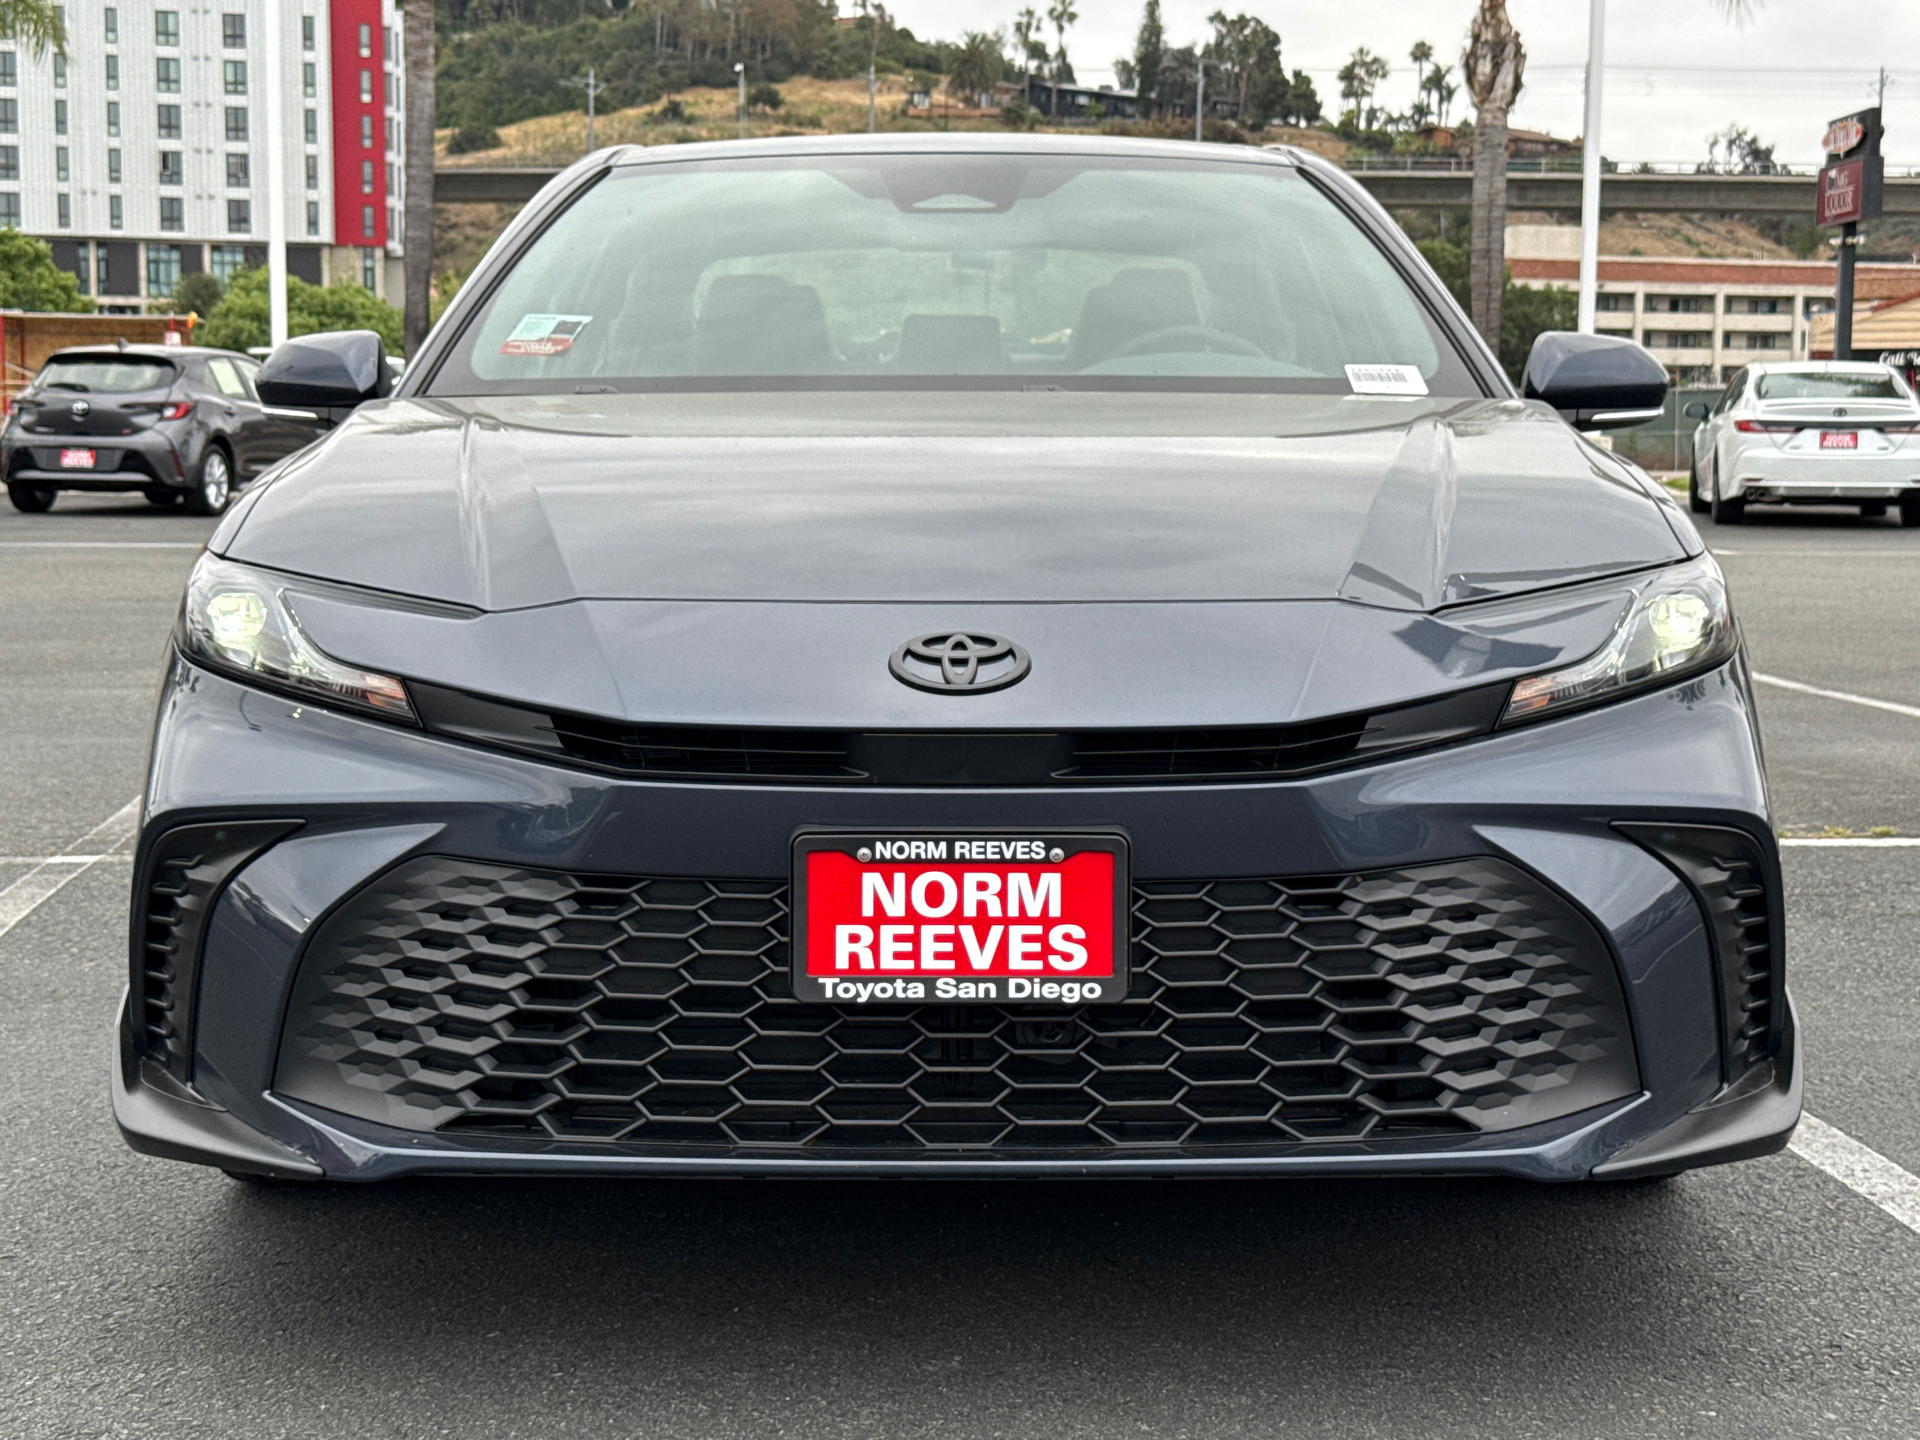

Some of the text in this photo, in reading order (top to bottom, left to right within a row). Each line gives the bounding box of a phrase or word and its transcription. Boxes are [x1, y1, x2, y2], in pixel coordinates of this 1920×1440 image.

[875, 841, 1046, 860] NORM REEVES
[861, 871, 1062, 918] NORM
[835, 924, 1088, 971] REEVES
[818, 978, 1102, 1003] Toyota San Diego
